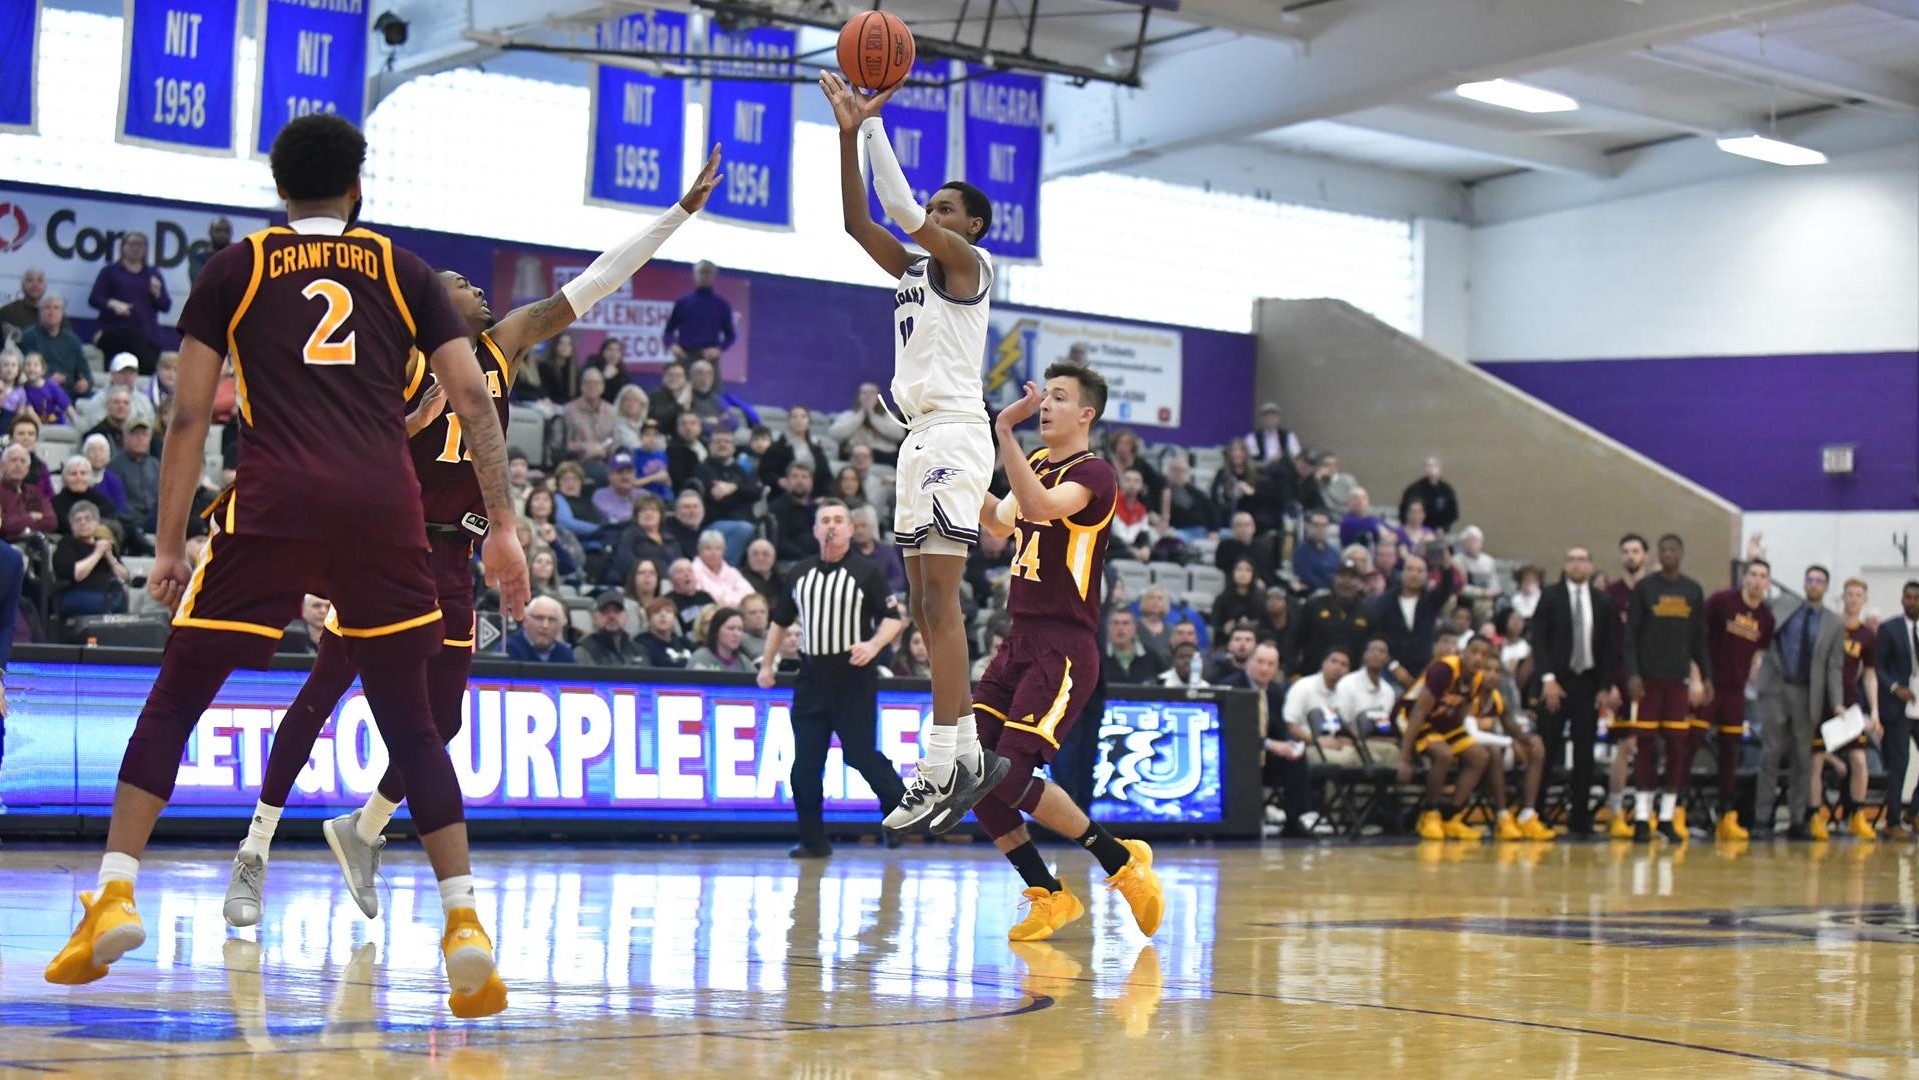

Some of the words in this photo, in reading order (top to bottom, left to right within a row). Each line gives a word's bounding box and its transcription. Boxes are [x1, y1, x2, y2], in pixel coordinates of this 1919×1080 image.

[165, 9, 202, 59] NIT
[296, 30, 333, 78] NIT
[153, 76, 206, 129] 1958
[623, 82, 655, 127] NIT
[734, 99, 766, 145] NIT
[615, 143, 660, 191] 1955
[893, 126, 922, 169] NIT
[988, 142, 1016, 183] NIT
[726, 161, 770, 208] 1954
[989, 202, 1024, 243] 950
[269, 241, 378, 281] CRAWFORD
[301, 278, 356, 365] 2
[1010, 527, 1041, 582] 24
[447, 689, 704, 799] URPLE
